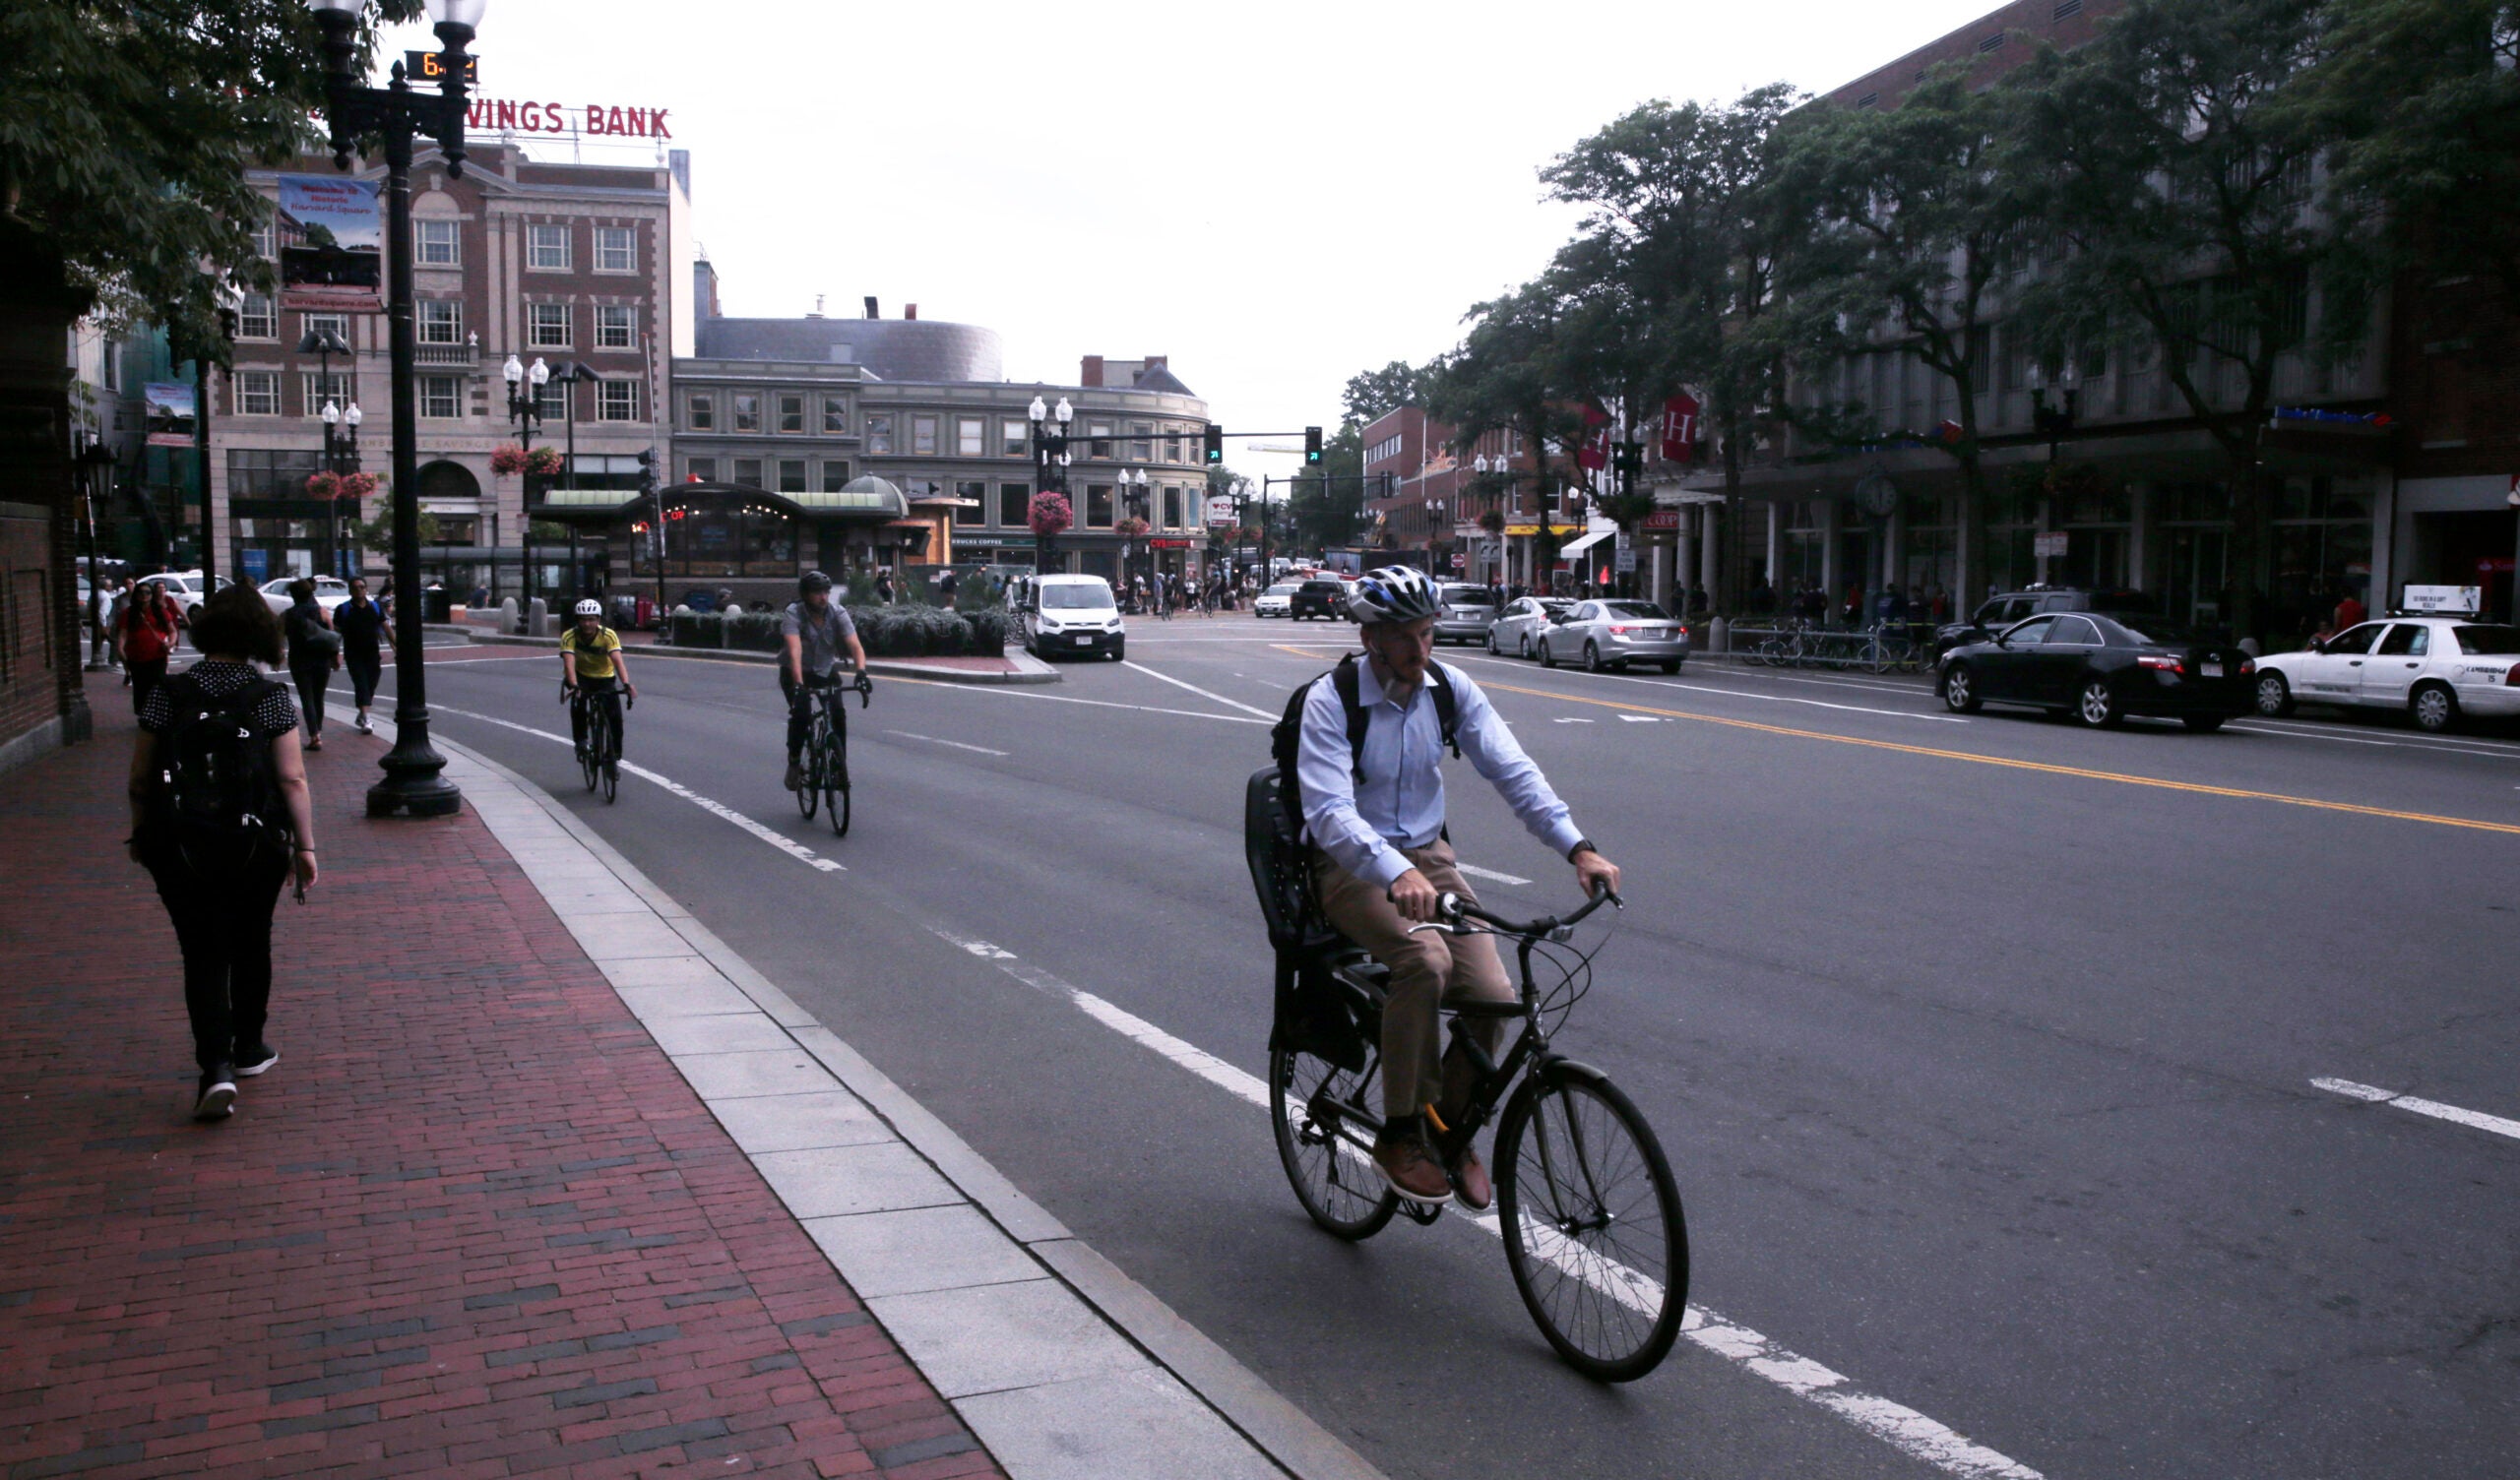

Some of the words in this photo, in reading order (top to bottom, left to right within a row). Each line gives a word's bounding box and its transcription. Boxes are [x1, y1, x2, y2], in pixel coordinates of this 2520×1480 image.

[466, 98, 562, 133] VINGS
[586, 103, 672, 139] BANK
[1667, 411, 1692, 444] H
[2466, 666, 2507, 675] CAMBRIDGE
